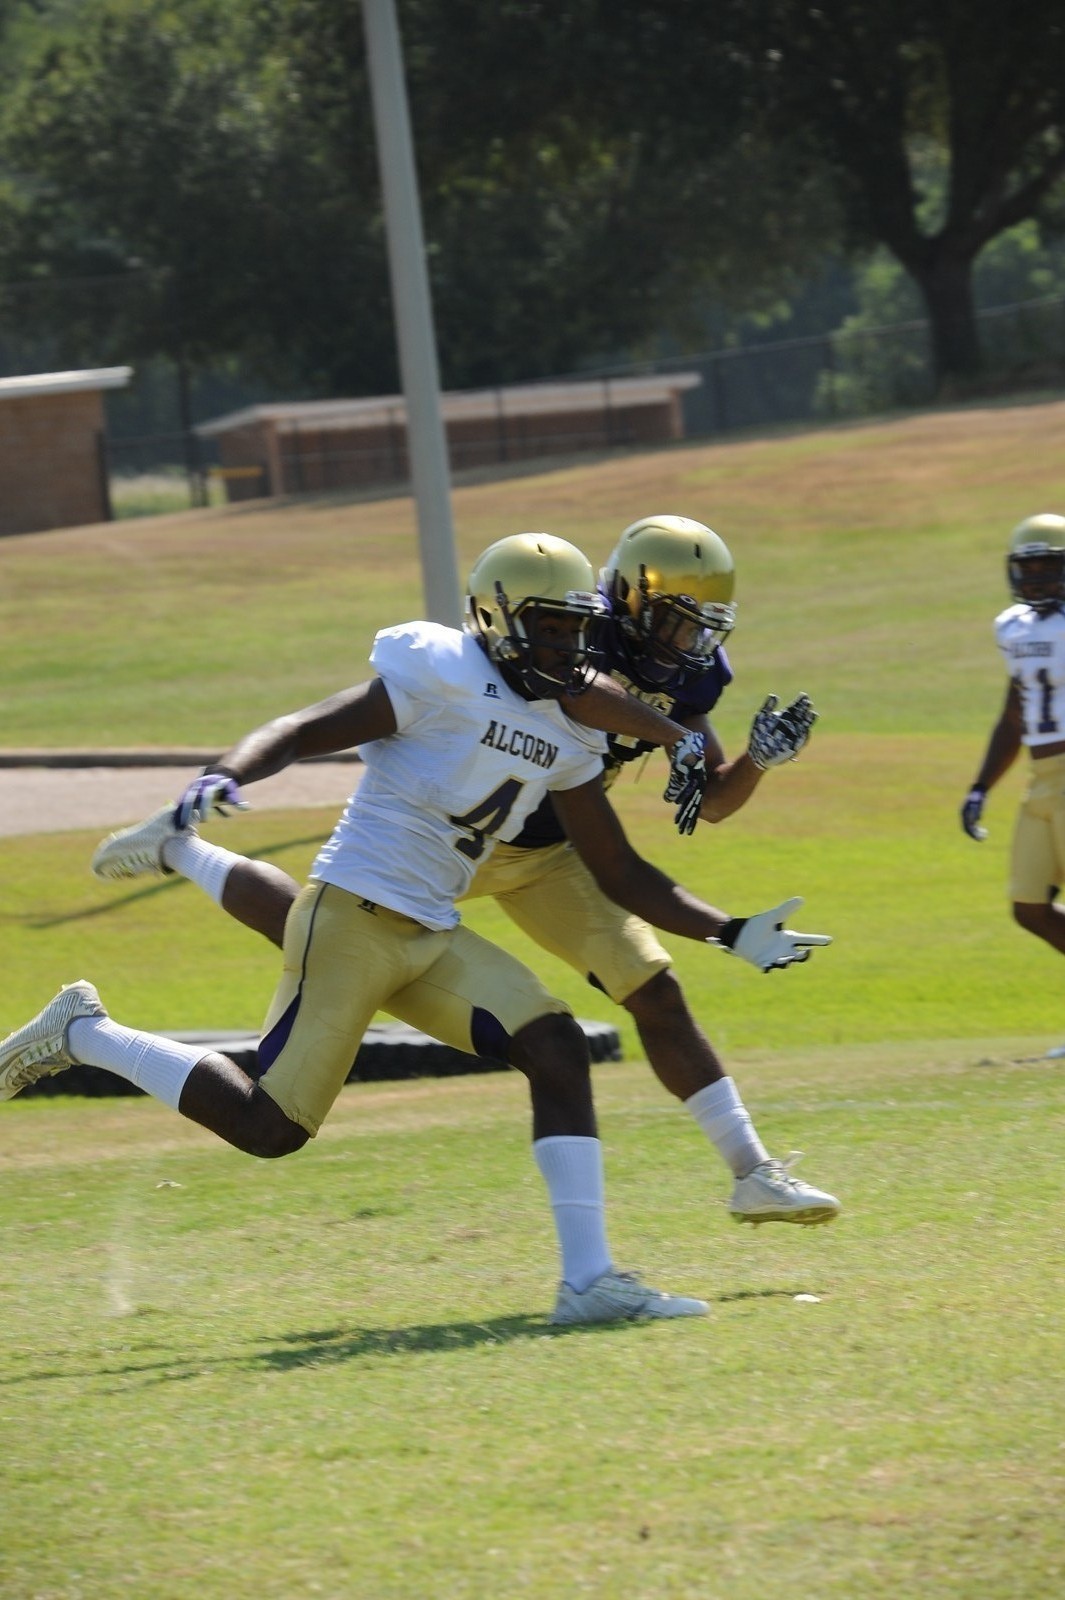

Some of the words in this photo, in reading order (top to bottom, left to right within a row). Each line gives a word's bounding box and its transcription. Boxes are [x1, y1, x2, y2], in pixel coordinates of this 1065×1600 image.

[485, 682, 498, 695] R
[1037, 667, 1057, 733] 1
[480, 719, 559, 770] ALCORN
[448, 775, 526, 862] 4
